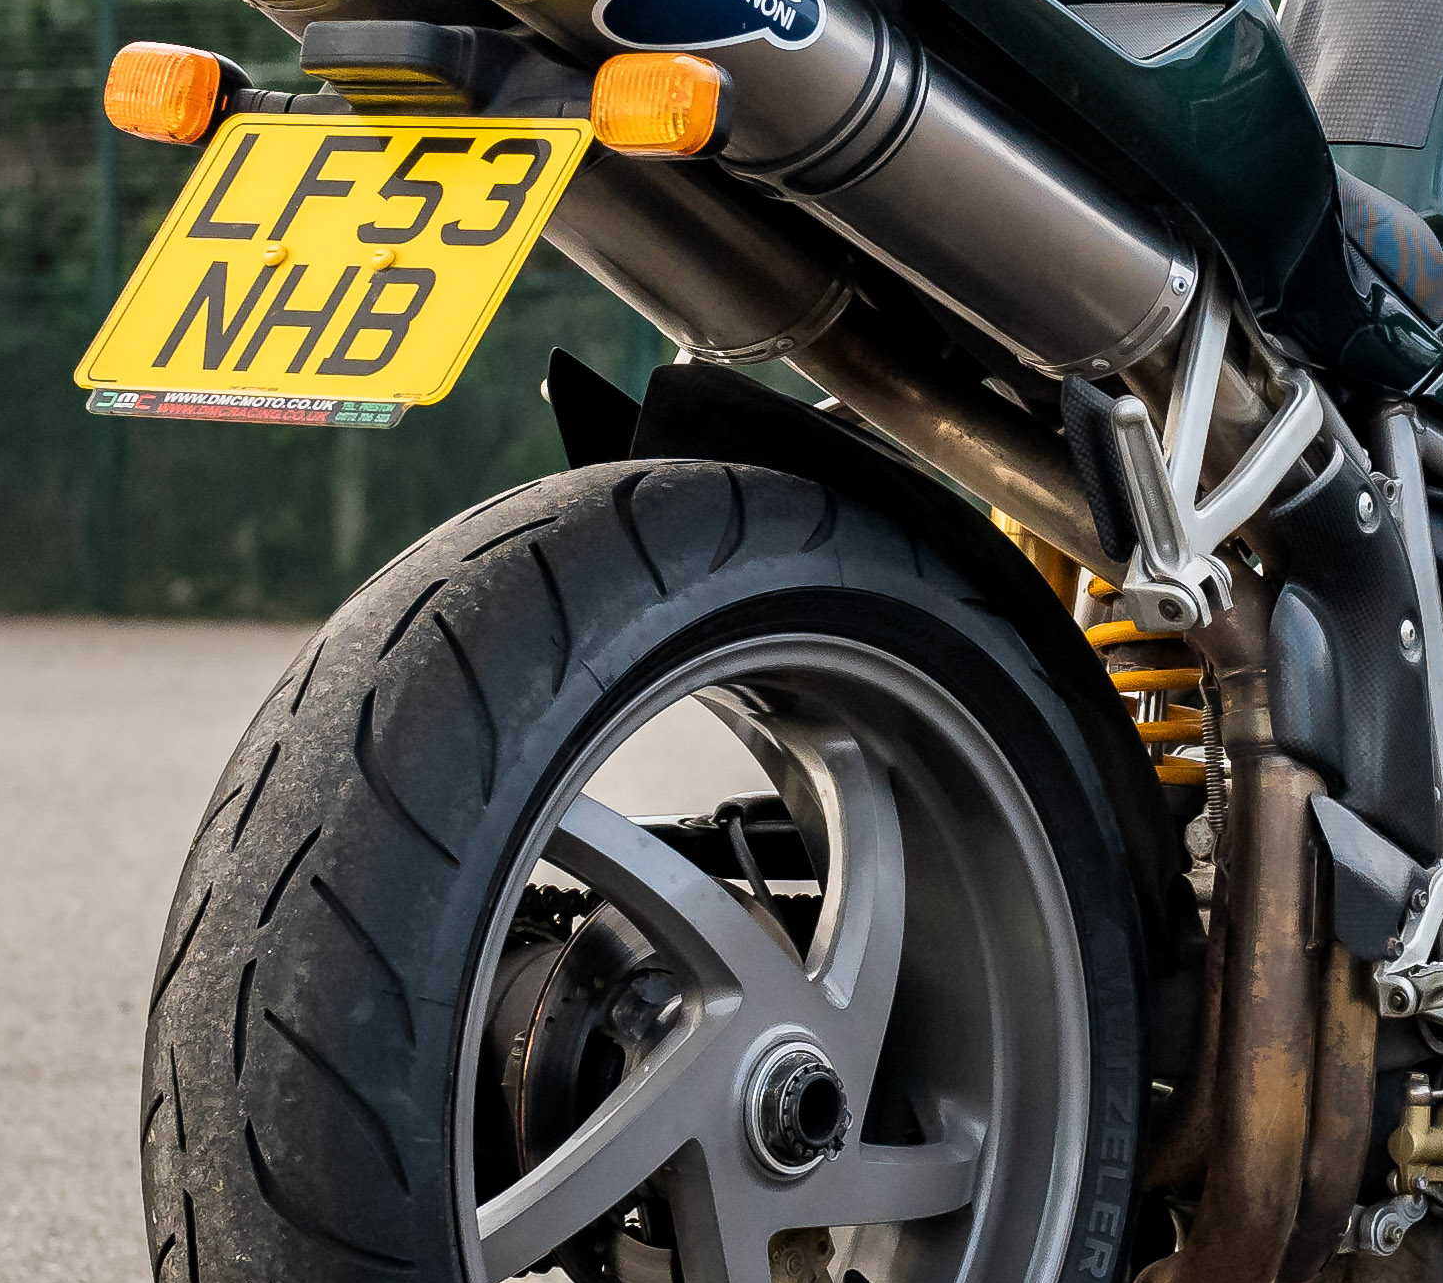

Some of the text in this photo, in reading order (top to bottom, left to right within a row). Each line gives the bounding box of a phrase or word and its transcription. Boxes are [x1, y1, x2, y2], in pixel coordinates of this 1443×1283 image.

[186, 133, 552, 246] LF53
[151, 261, 437, 376] NHB
[163, 392, 338, 411] WWW.DMCMOTO.CO.UK
